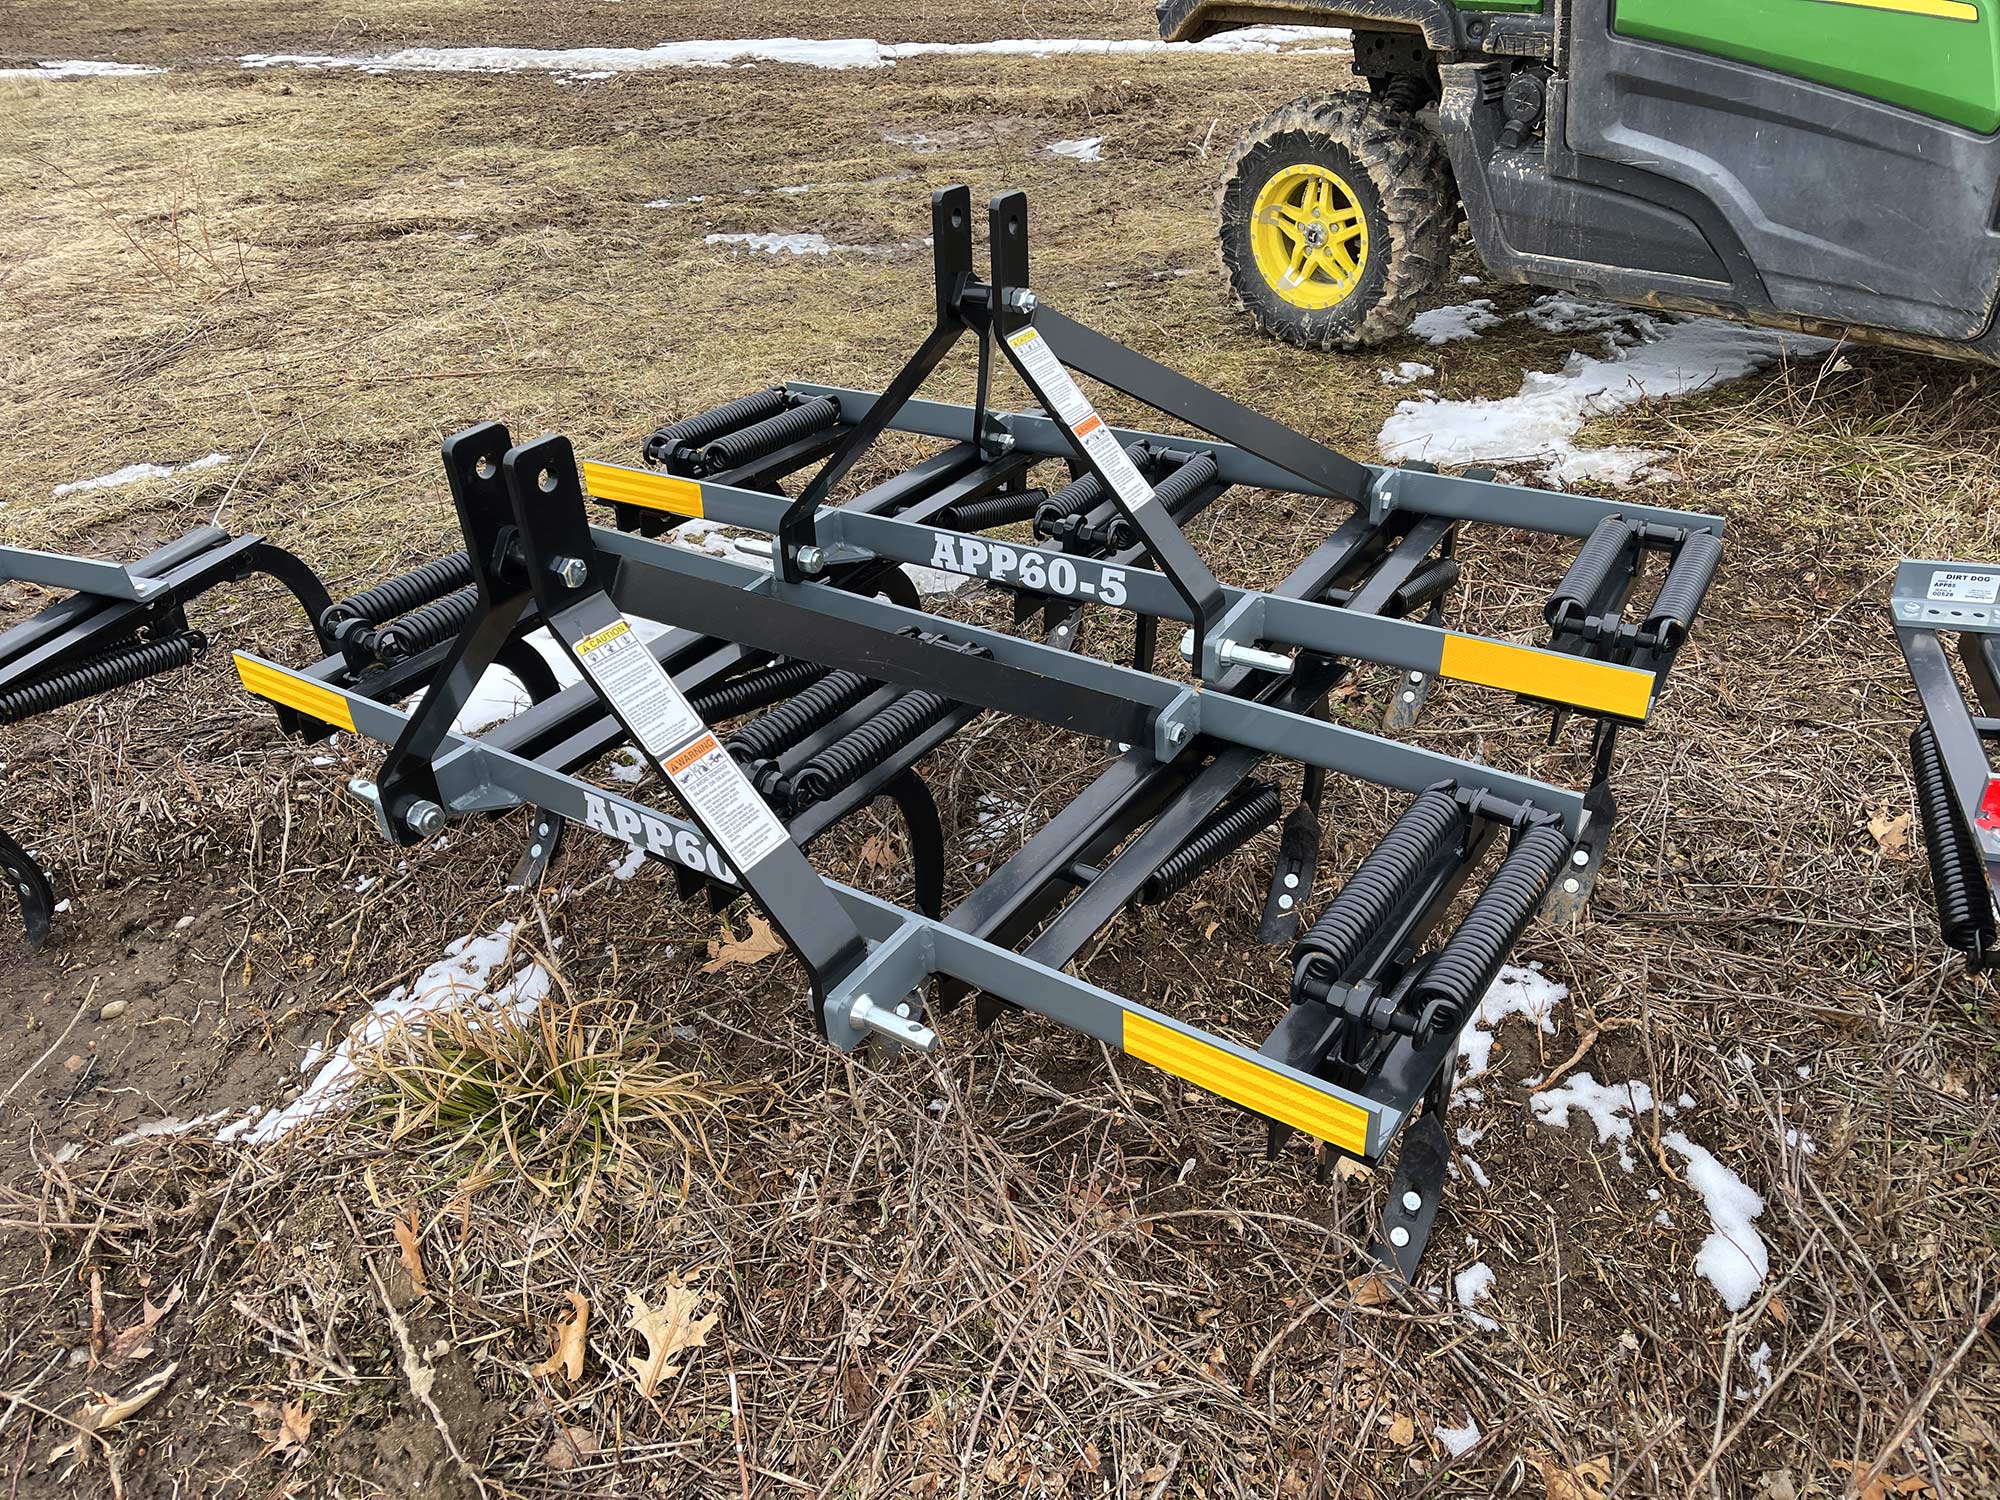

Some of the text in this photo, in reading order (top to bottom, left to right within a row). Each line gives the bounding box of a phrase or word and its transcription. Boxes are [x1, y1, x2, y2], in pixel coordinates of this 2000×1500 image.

[930, 532, 1127, 606] APP60-5
[590, 625, 625, 648] CAUTION
[675, 738, 715, 767] WARNING
